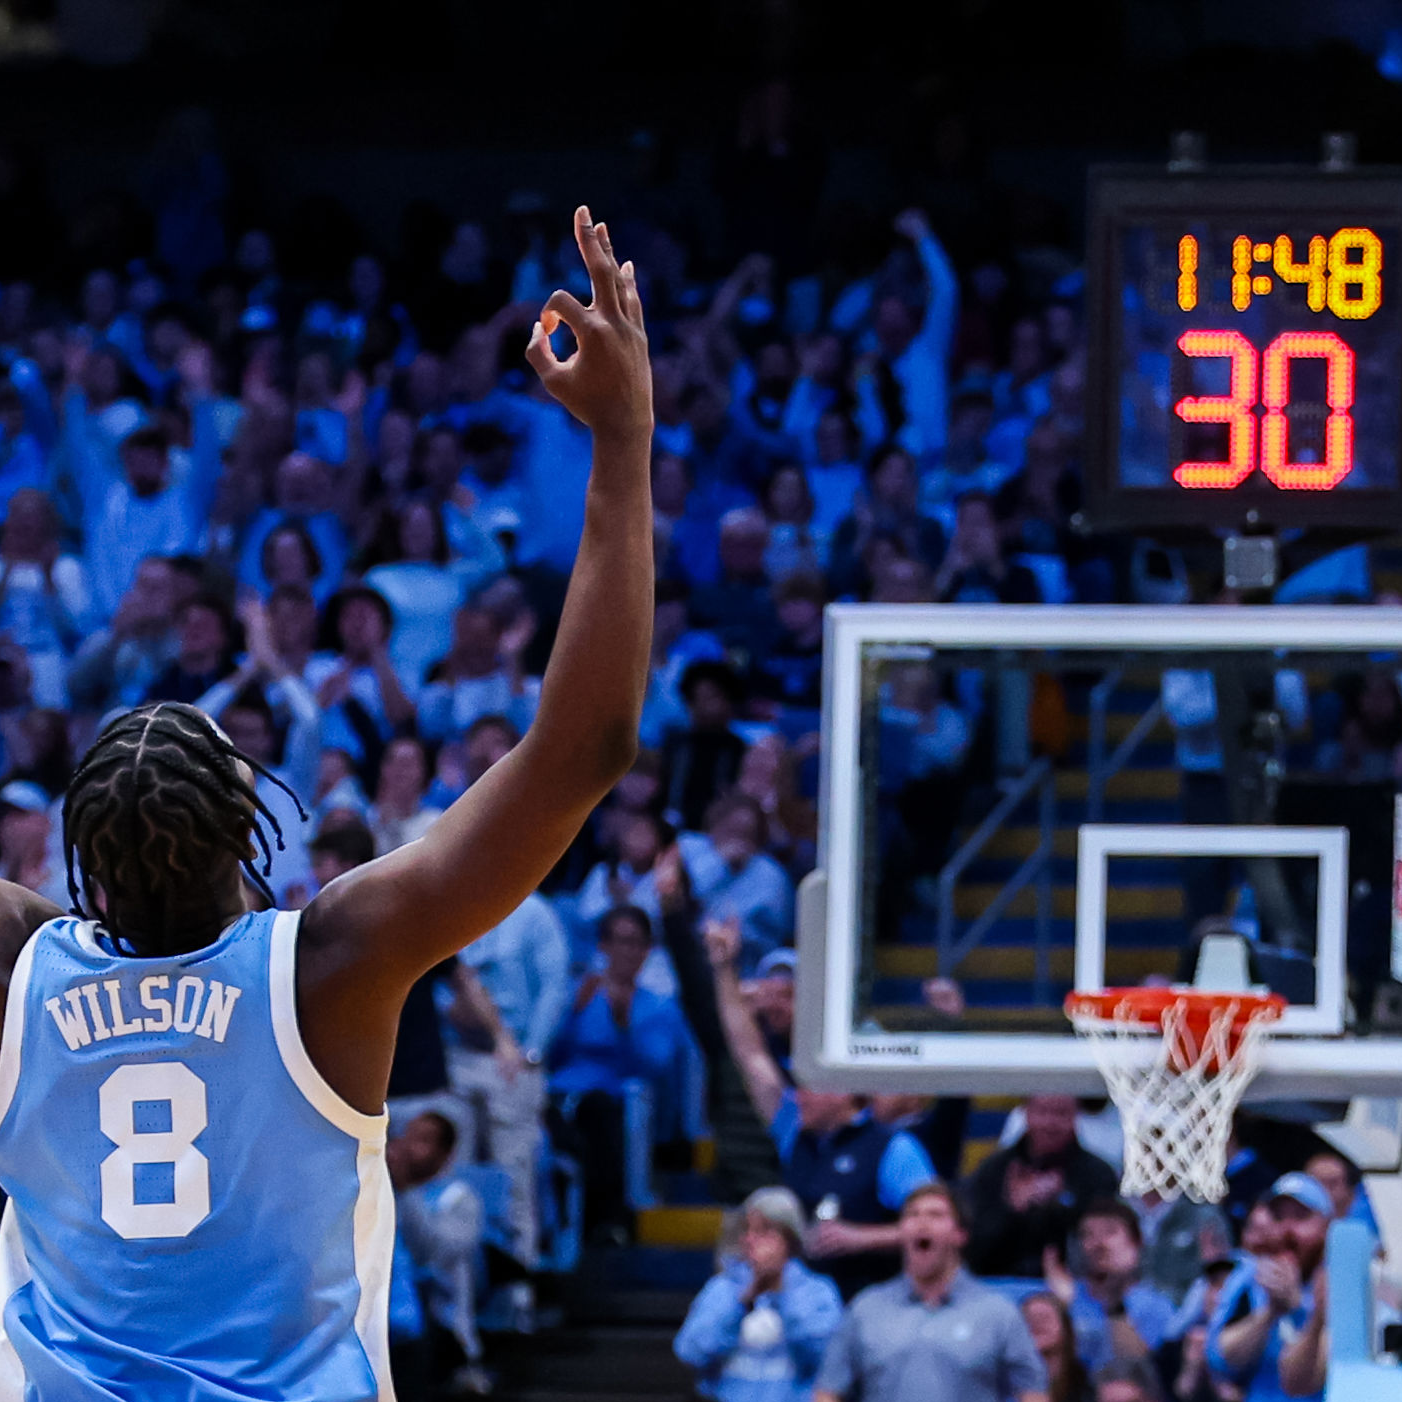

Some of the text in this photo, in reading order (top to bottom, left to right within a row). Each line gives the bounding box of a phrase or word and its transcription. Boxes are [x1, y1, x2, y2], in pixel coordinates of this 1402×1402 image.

[1178, 227, 1383, 320] 11:48
[1173, 329, 1356, 491] 30
[45, 975, 242, 1051] WILSON
[99, 1062, 210, 1240] 8
